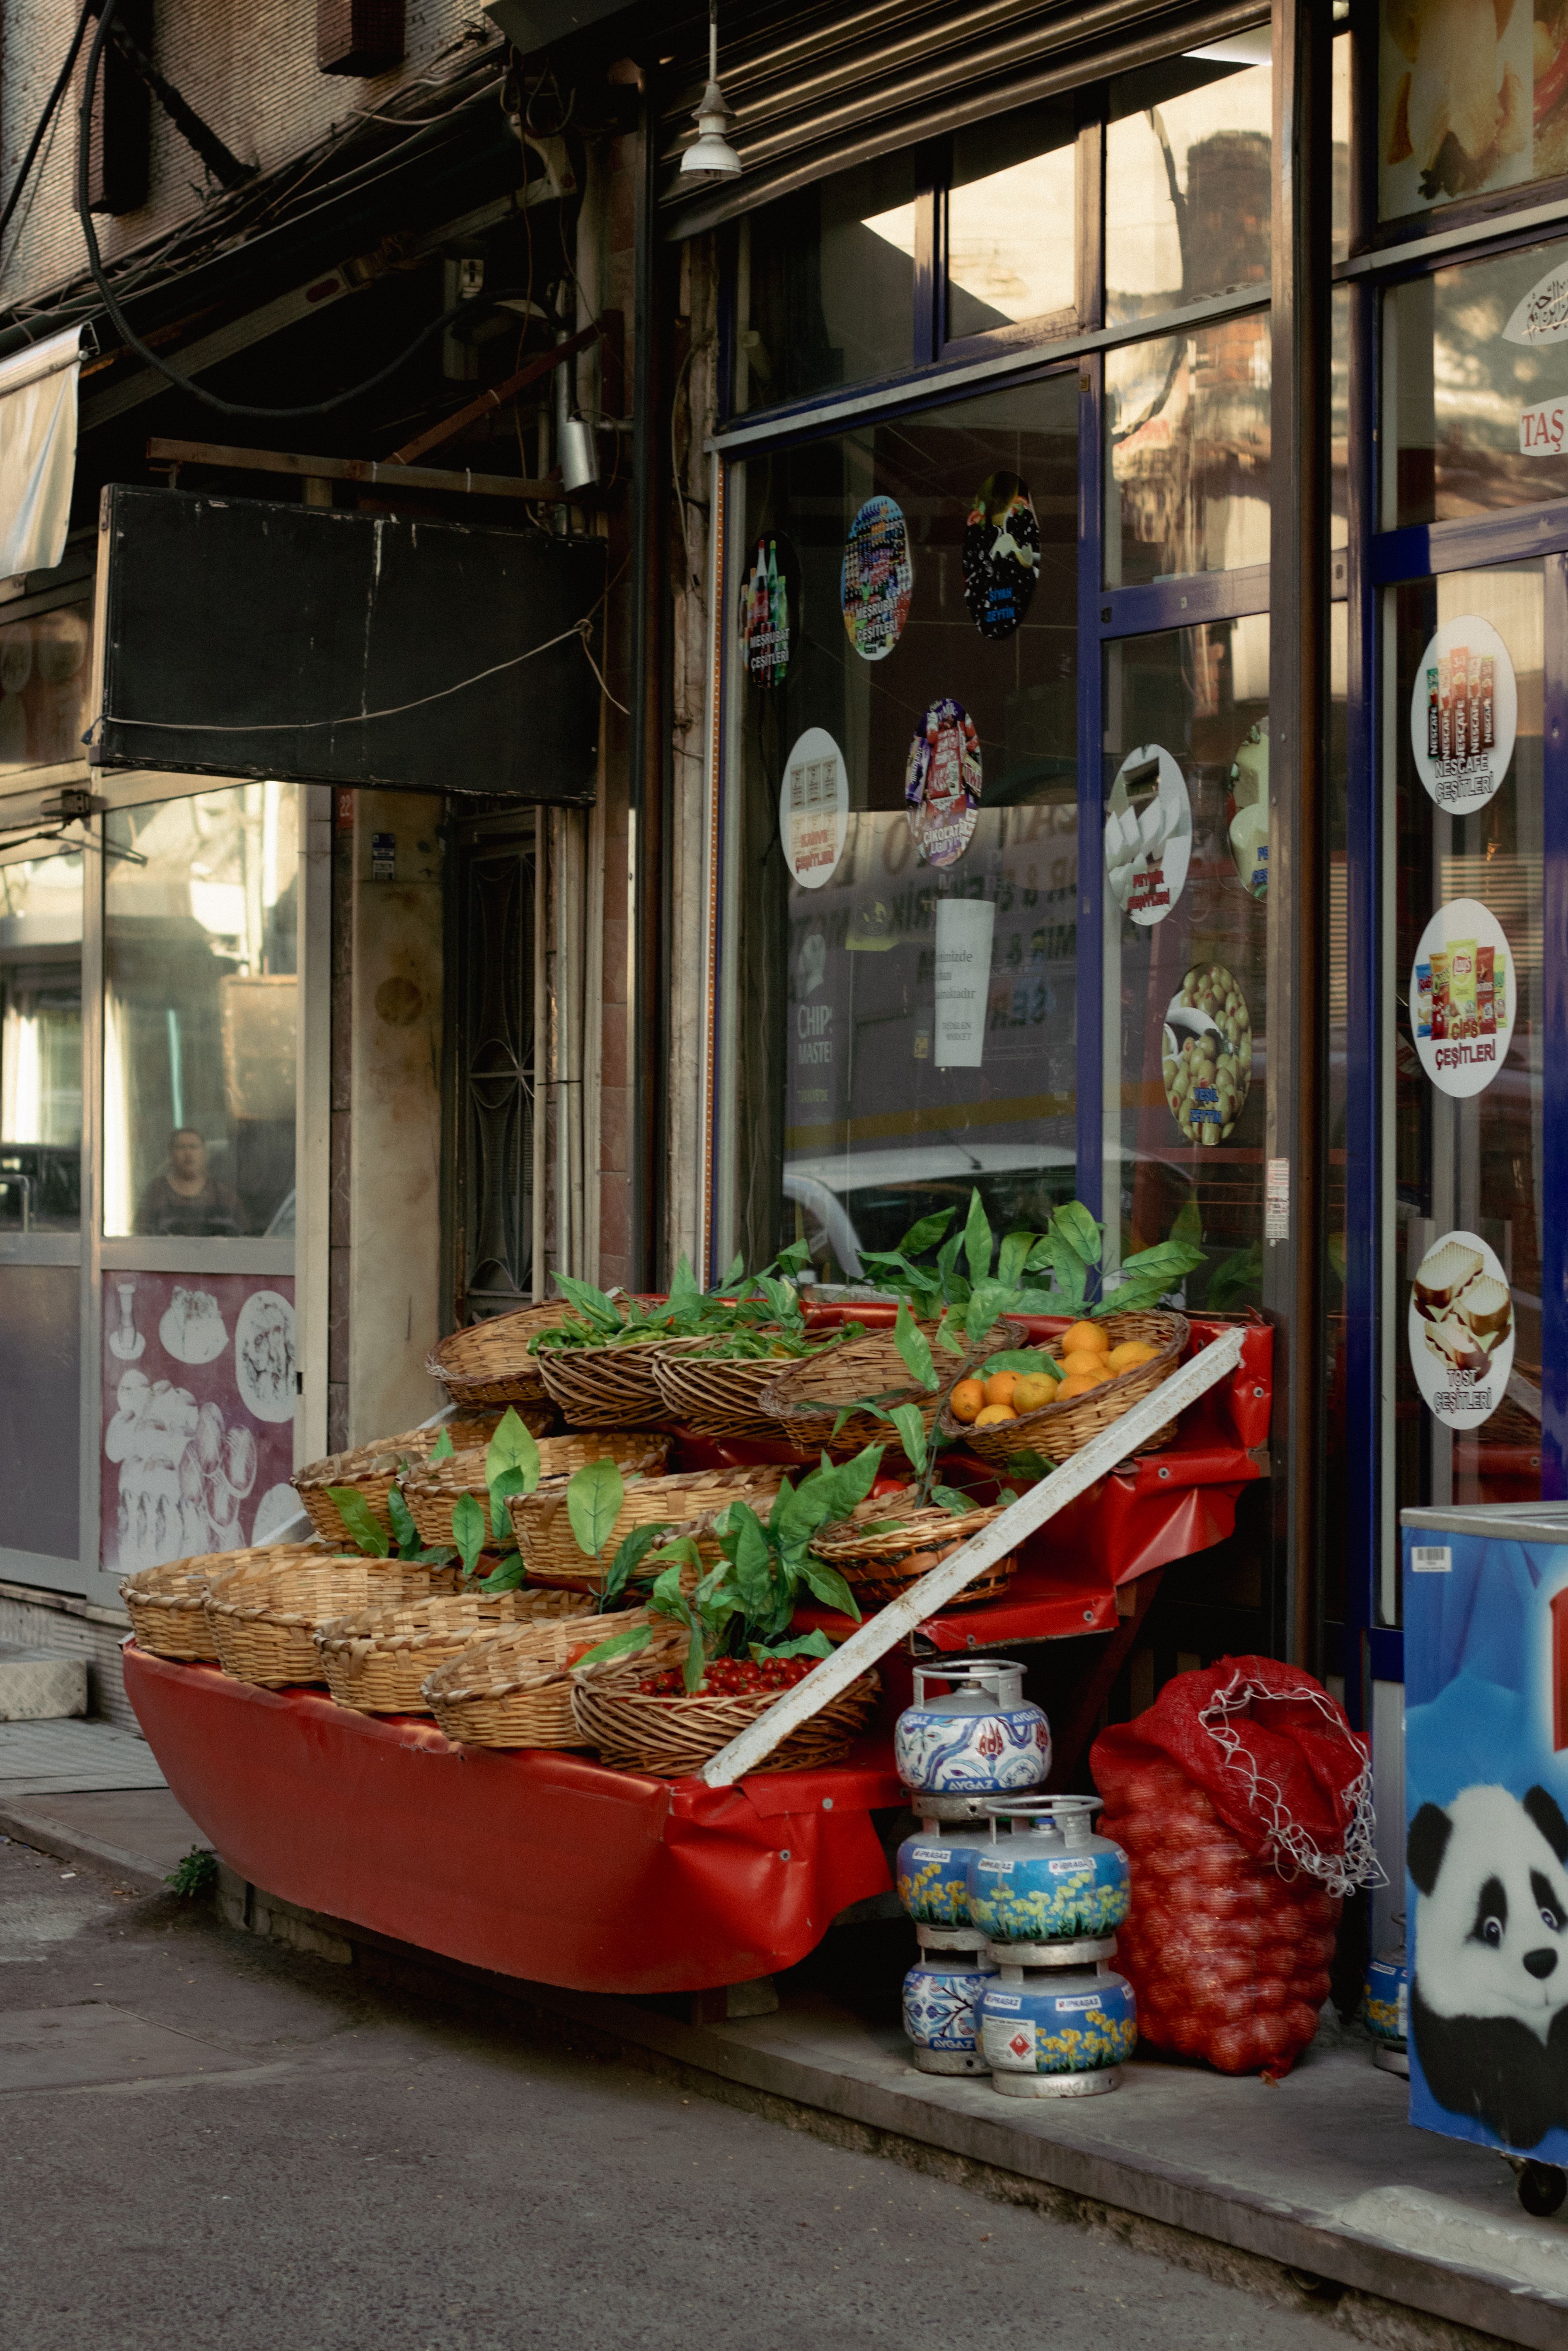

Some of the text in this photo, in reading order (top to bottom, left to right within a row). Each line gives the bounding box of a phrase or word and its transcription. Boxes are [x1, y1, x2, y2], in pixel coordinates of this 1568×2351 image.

[1522, 409, 1564, 452] TAŞ
[855, 596, 899, 620] MEŞRUBAT
[750, 628, 790, 649] MEŞRUBAT
[857, 616, 898, 645] ÇEŞİTLERİ
[750, 647, 789, 672] ÇEŞİTLERİ
[1435, 753, 1488, 778] NESCAFE
[1435, 771, 1493, 804] ÇEŞİTLERİ
[1128, 888, 1170, 911] ÇEŞİTLERİ
[798, 1004, 832, 1040] CHIP
[1452, 1018, 1478, 1040] CİPS
[1435, 1038, 1496, 1071] ÇEŞİTLERİ
[1193, 1085, 1219, 1105] YEŞİL
[1189, 1107, 1222, 1124] ZEYTİN
[1446, 1369, 1477, 1387] TOST
[1433, 1387, 1492, 1414] ÇEŞİTLERİ
[1012, 1709, 1040, 1724] AYGAZ
[947, 1779, 994, 1790] AYGAZ
[933, 2039, 974, 2049] AYGAZ
